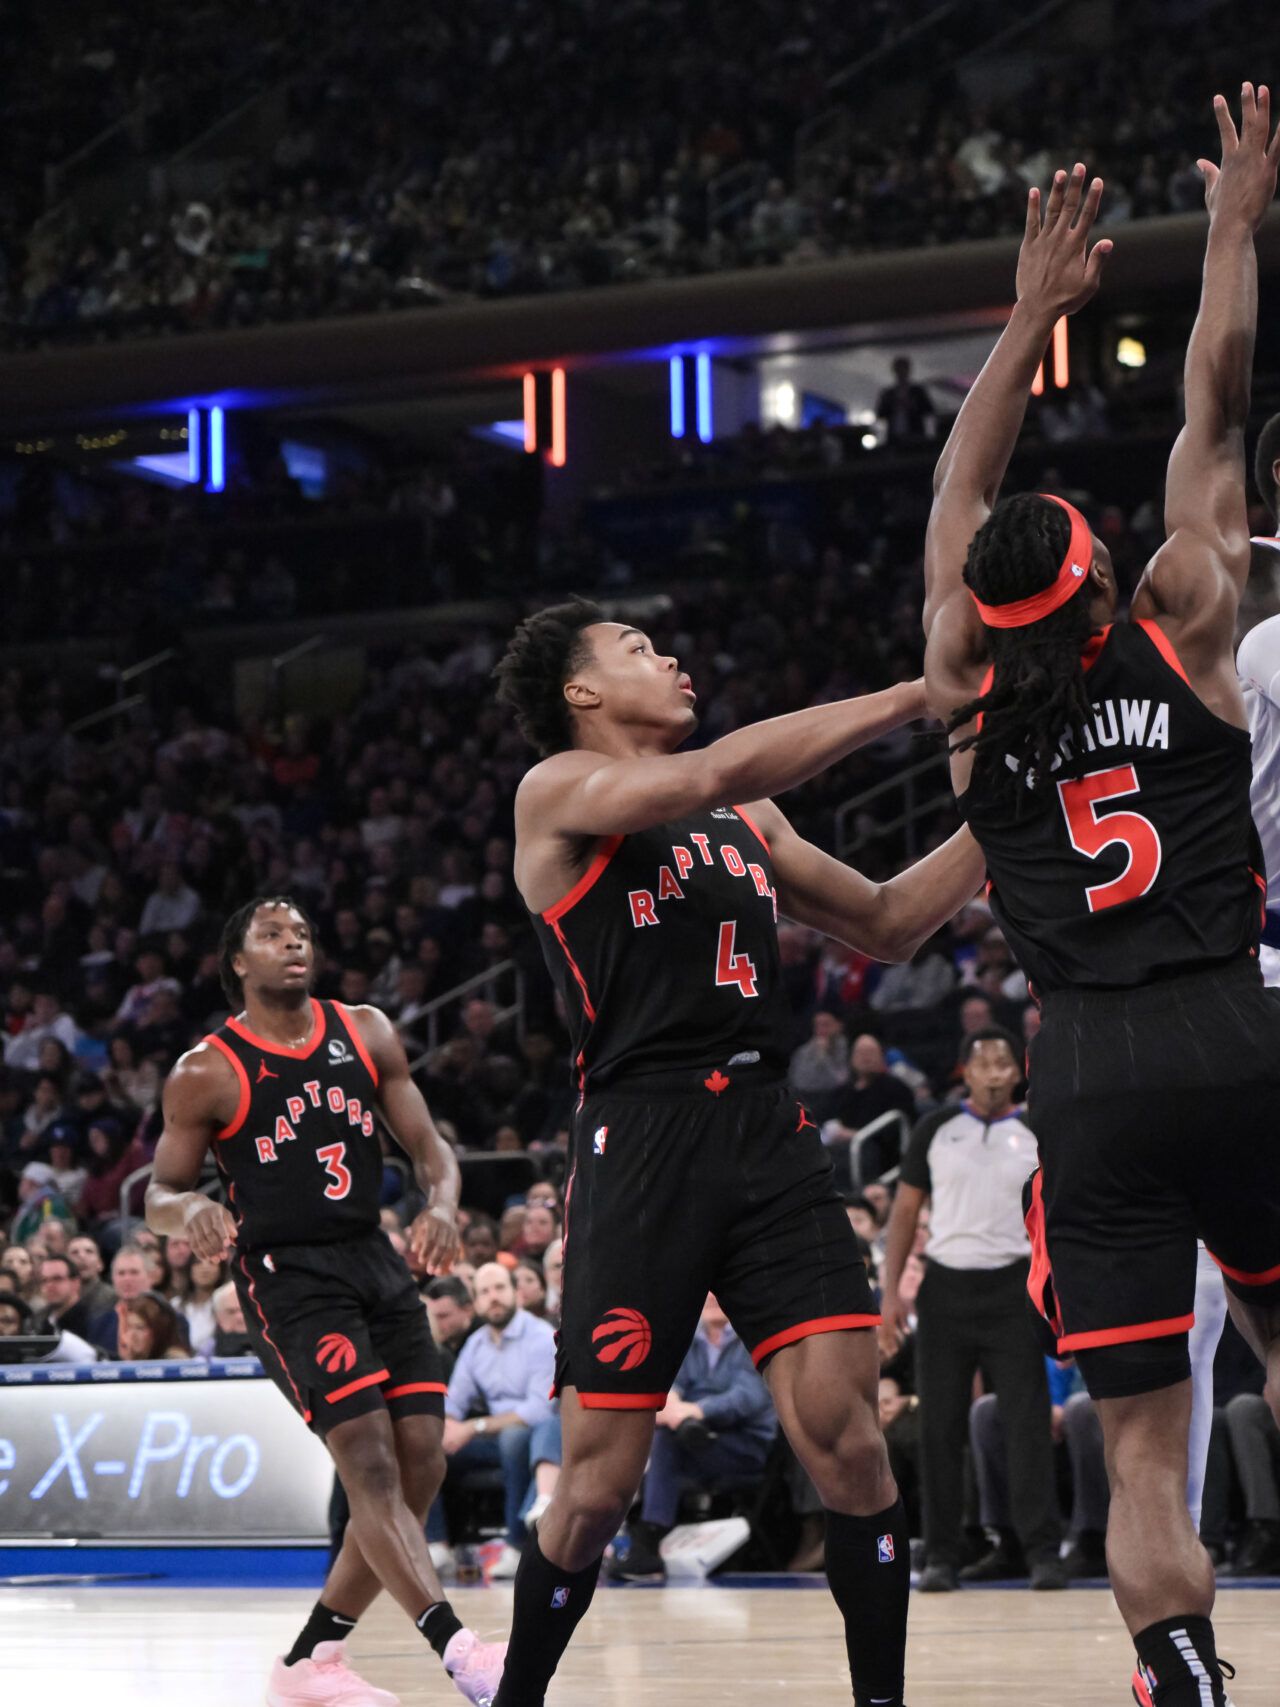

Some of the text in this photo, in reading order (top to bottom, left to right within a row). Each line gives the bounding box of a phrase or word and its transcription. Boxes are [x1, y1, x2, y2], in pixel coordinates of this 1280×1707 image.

[1057, 762, 1162, 912] 5
[715, 920, 759, 998] 4
[255, 1080, 374, 1164] RAPTORS
[316, 1142, 352, 1200] 3
[29, 1411, 260, 1500] X-Pro
